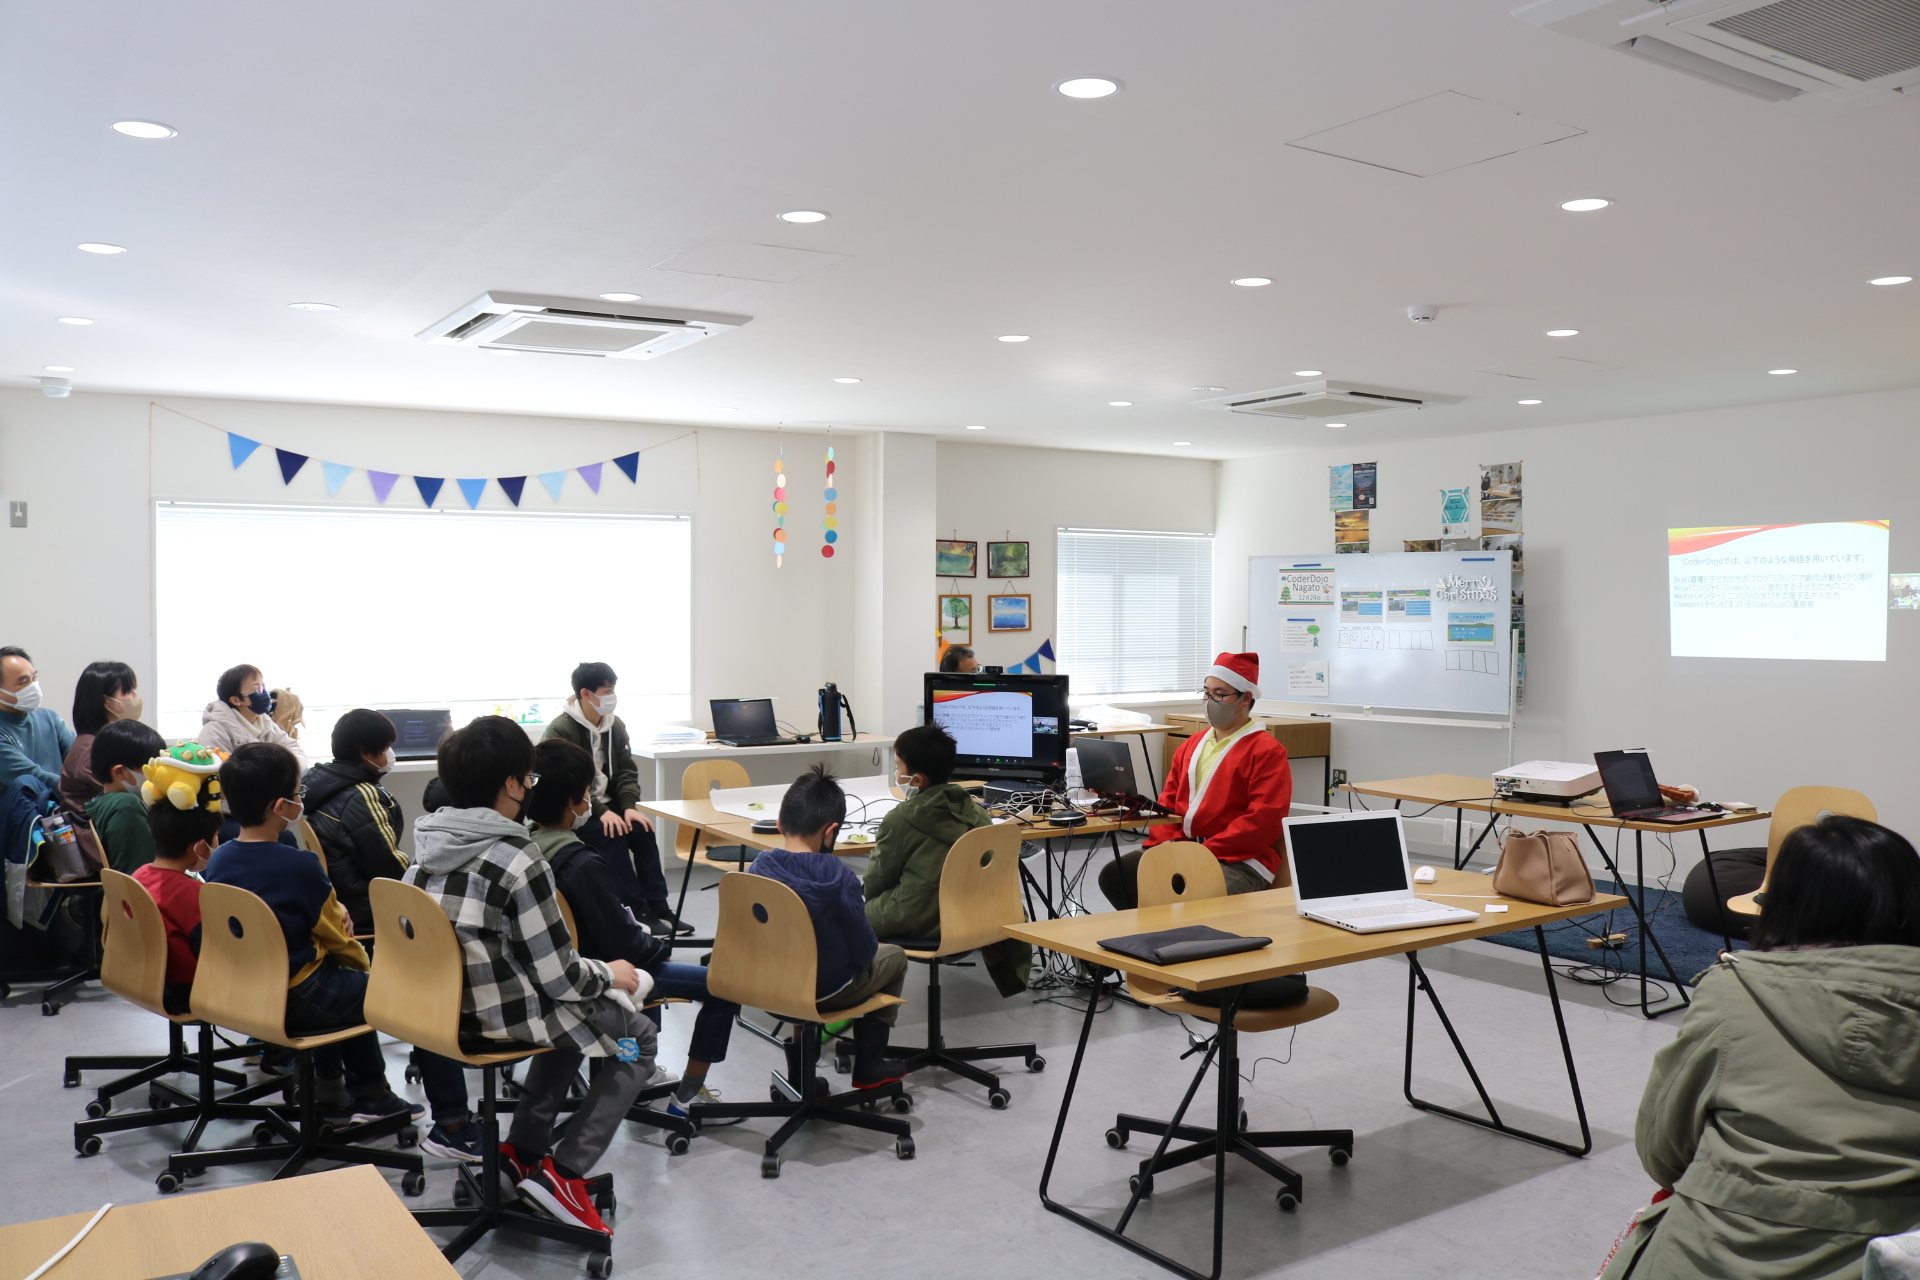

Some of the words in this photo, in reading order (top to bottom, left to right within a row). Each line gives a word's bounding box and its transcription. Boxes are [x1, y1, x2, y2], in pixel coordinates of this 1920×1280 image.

[1682, 554, 1866, 566] CoderDojoでは、以下のような用語を用いています。
[1286, 574, 1329, 585] CoderDojo
[1446, 575, 1486, 589] Merry
[1292, 583, 1321, 593] Nagato
[1436, 588, 1498, 602] Christmas
